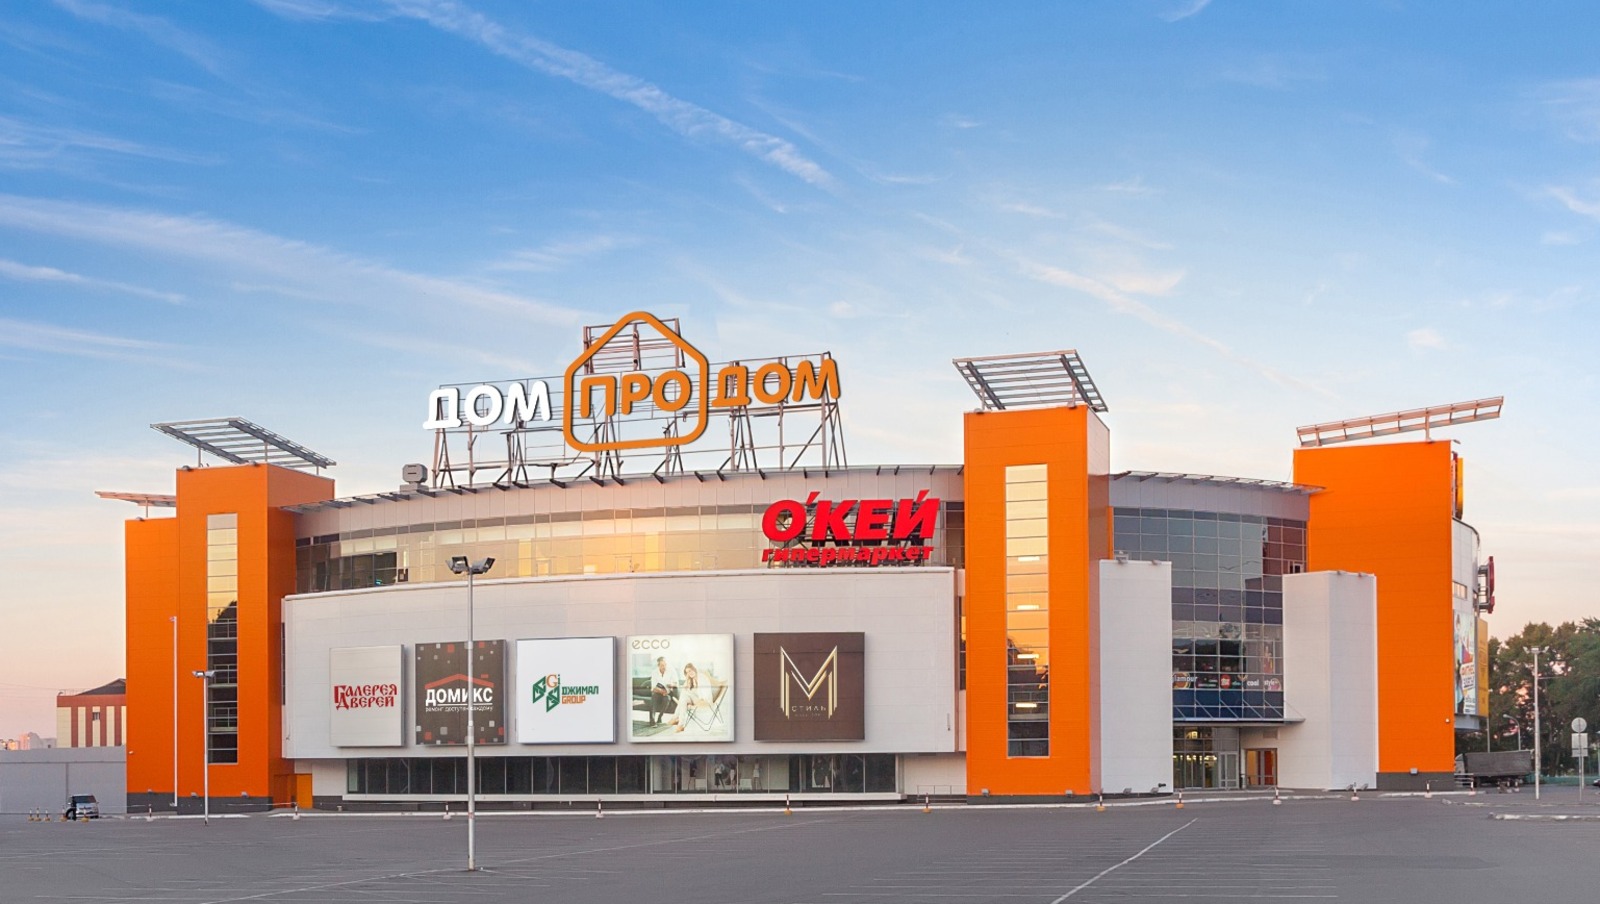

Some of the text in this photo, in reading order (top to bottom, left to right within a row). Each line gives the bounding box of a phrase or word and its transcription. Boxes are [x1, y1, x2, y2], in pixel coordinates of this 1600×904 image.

[422, 358, 841, 430] ДОМ ПРО ДОМ
[761, 545, 934, 567] гипермаркет
[631, 639, 670, 650] ecco
[425, 687, 494, 706] ДОМИКС
[561, 695, 586, 705] GROUP
